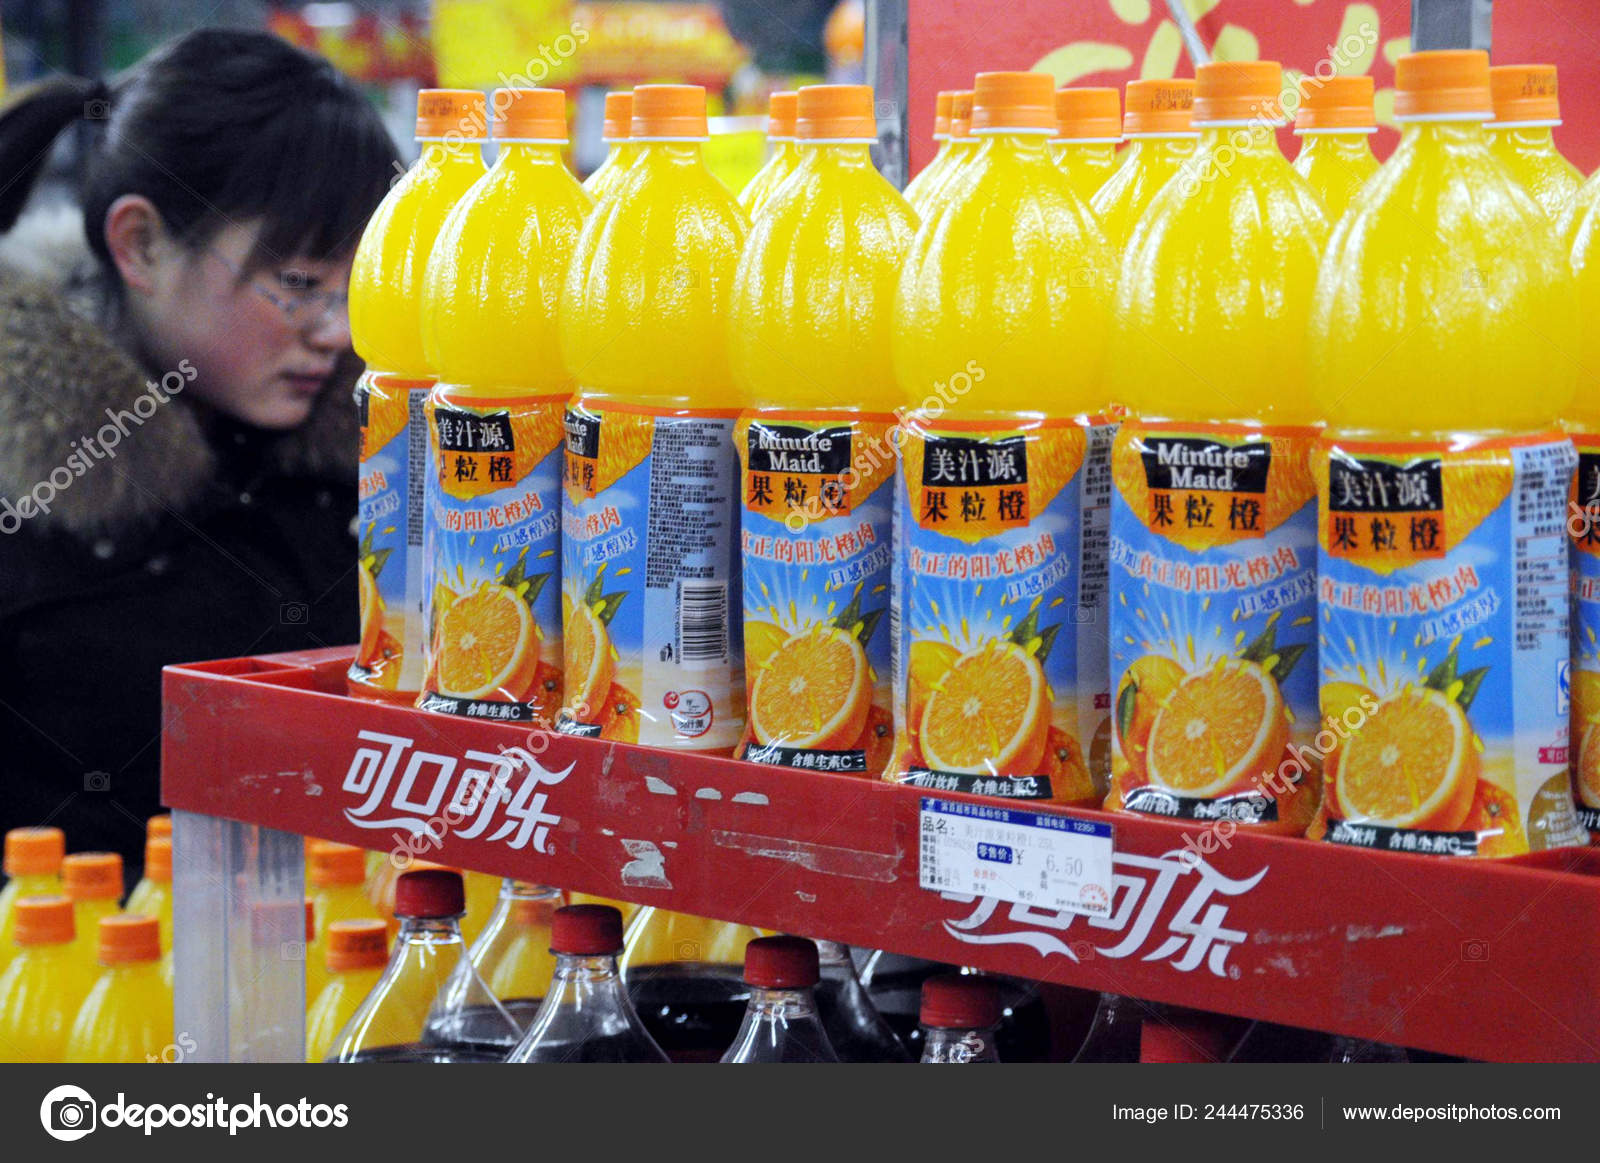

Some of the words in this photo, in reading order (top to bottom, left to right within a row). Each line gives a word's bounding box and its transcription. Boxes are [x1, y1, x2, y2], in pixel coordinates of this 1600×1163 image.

[440, 418, 505, 448] 美汁源
[759, 430, 832, 451] Minute
[769, 451, 821, 473] Maid
[931, 447, 1018, 482] 美汁源
[1157, 443, 1249, 468] Minute
[1170, 466, 1234, 490] Maid
[1337, 472, 1431, 508] 美汁源
[922, 489, 1026, 523] 果粒橙
[1151, 493, 1261, 531] 果粒橙
[1333, 517, 1440, 552] 果粒橙
[910, 533, 1056, 579] 真正的阳光橙肉
[1240, 572, 1317, 614] 口感醇厚
[1321, 565, 1479, 614] 真正的阳光橙肉
[791, 754, 851, 769] 含维生素C
[342, 730, 577, 855] 可口可乐
[1045, 854, 1083, 877] 6.50
